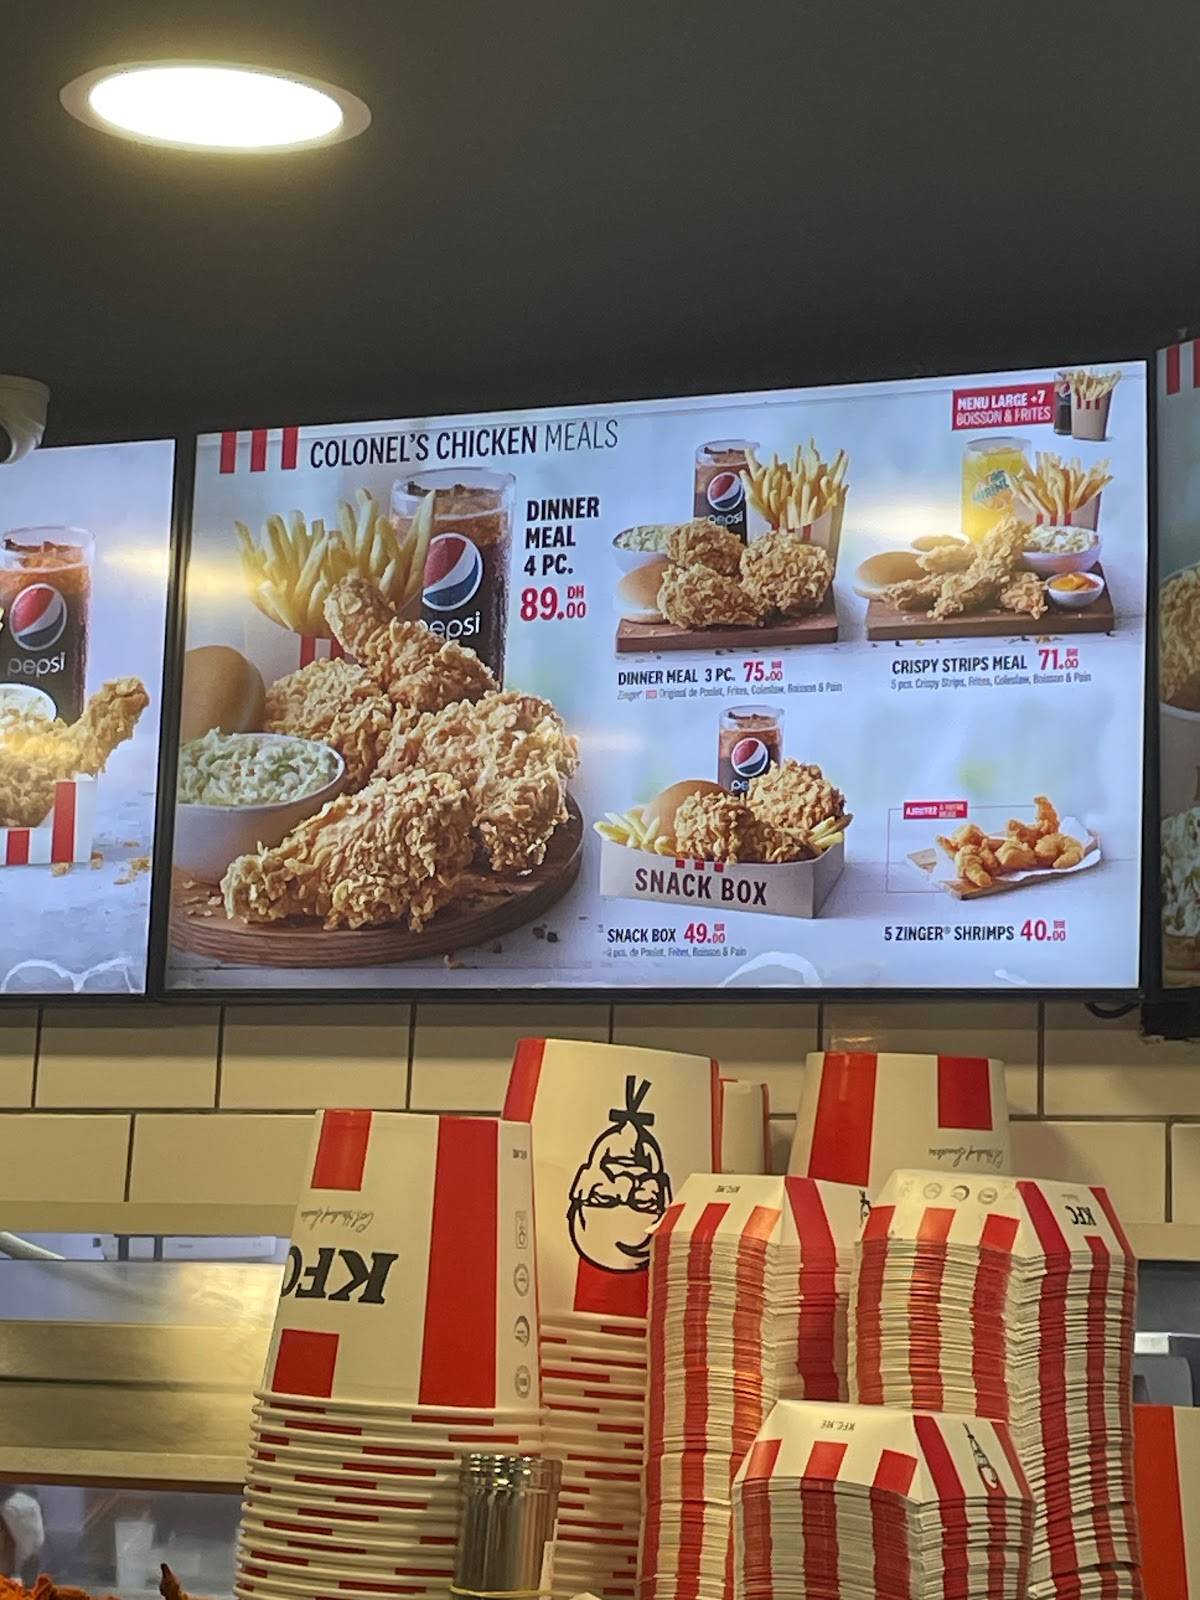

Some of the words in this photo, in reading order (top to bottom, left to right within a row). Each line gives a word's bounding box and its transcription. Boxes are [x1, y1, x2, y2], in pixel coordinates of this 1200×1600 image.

[957, 397, 989, 411] MENU
[992, 393, 1027, 408] LARGE
[956, 410, 1001, 426] BOISSON
[1004, 409, 1012, 422] &
[1015, 406, 1051, 422] FRITES
[310, 433, 429, 468] COLONEL'S
[436, 425, 537, 460] CHICKEN
[545, 419, 619, 452] MEALS
[526, 496, 600, 521] DINNER
[525, 525, 576, 549] MEAL
[524, 555, 537, 576] 4
[542, 554, 574, 575] PC.
[8, 652, 66, 678] pepsi
[892, 658, 939, 674] CRISPY
[942, 657, 989, 672] STRIPS
[993, 655, 1027, 671] MEAL
[618, 670, 663, 686] DINNER
[666, 669, 698, 683] MEAL
[705, 668, 712, 682] 3
[715, 667, 735, 682] PC.
[635, 867, 713, 900] SNACK
[721, 877, 767, 906] BOX
[607, 928, 648, 943] SNACK
[652, 928, 676, 943] BOX
[884, 927, 892, 941] 5
[954, 926, 1014, 941] SHRIMPS
[1065, 1205, 1097, 1226] KFC
